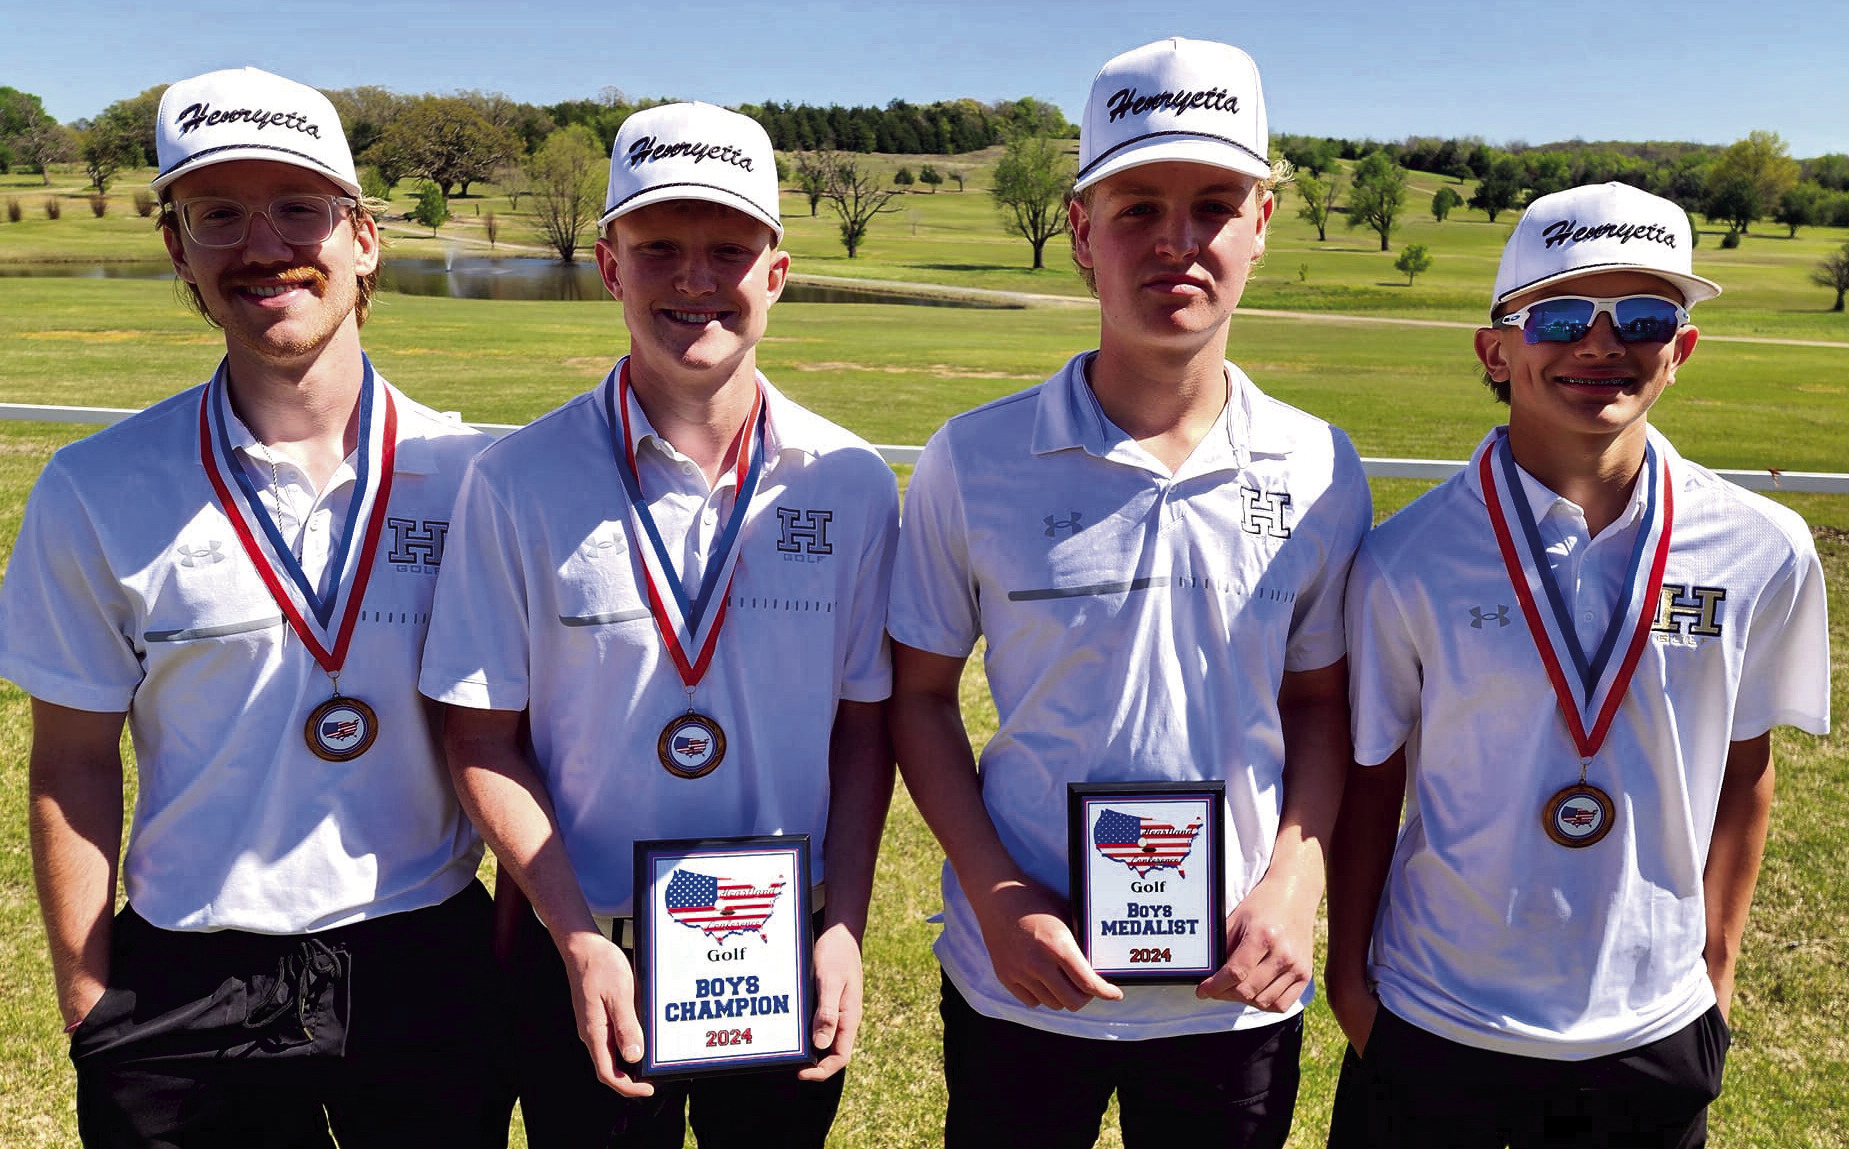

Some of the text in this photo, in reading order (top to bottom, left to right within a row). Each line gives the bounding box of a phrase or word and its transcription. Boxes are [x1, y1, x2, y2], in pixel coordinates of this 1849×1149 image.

[1107, 87, 1240, 123] Henryetta
[179, 102, 321, 140] Henryetta
[628, 136, 754, 172] Henryetta
[1542, 219, 1677, 249] Henryetta
[1240, 486, 1291, 539] H
[388, 517, 449, 566] H
[777, 507, 832, 554] H
[1652, 584, 1726, 637] H
[1130, 881, 1166, 893] Golf
[1101, 919, 1199, 936] MEDALIST
[707, 947, 747, 962] Golf
[1130, 948, 1172, 963] 2024
[695, 975, 760, 999] BOYS
[665, 994, 790, 1022] CHAMPION
[705, 1027, 753, 1048] 2024
